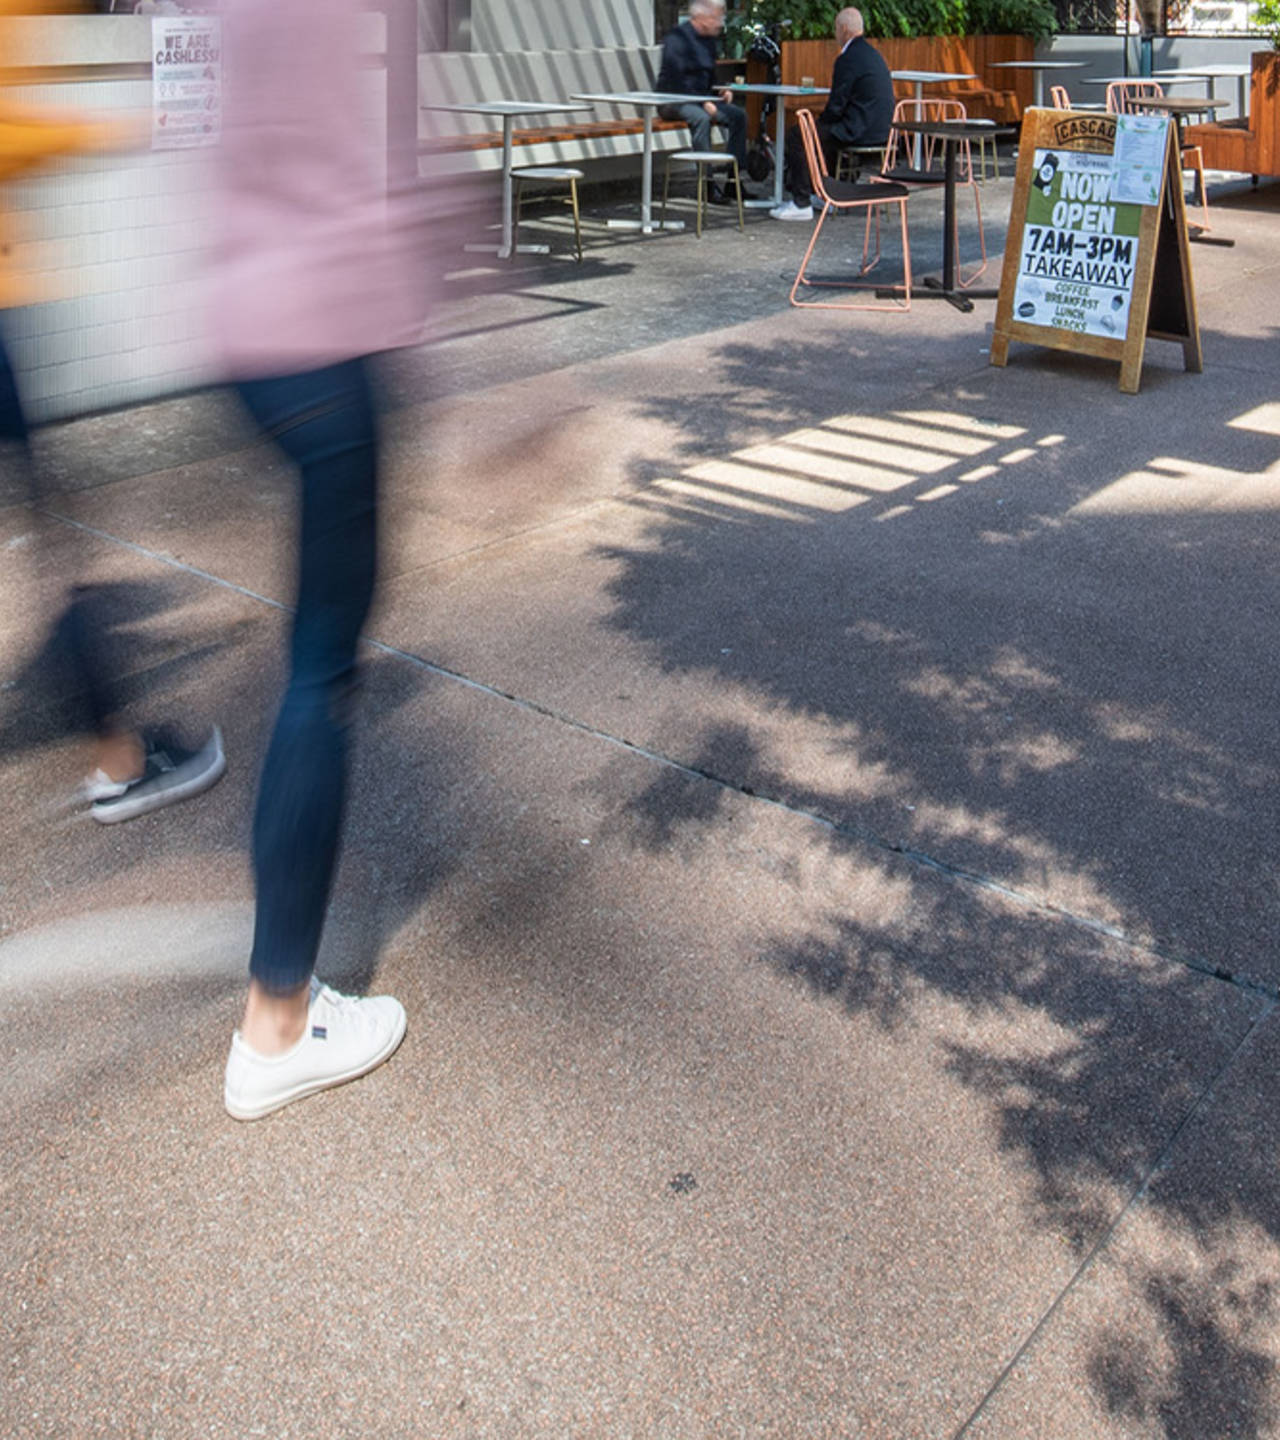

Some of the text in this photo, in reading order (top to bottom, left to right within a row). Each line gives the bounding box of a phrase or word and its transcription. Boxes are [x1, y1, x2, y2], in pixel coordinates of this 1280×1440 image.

[164, 33, 210, 50] WE ARE
[1051, 200, 1116, 235] OPEN
[1024, 253, 1132, 287] TAKEAWAY
[1054, 282, 1092, 297] COFFEE
[1045, 291, 1100, 310] BREAKFAST
[1055, 306, 1086, 321] LUNCH
[1051, 317, 1087, 333] SNACKS
